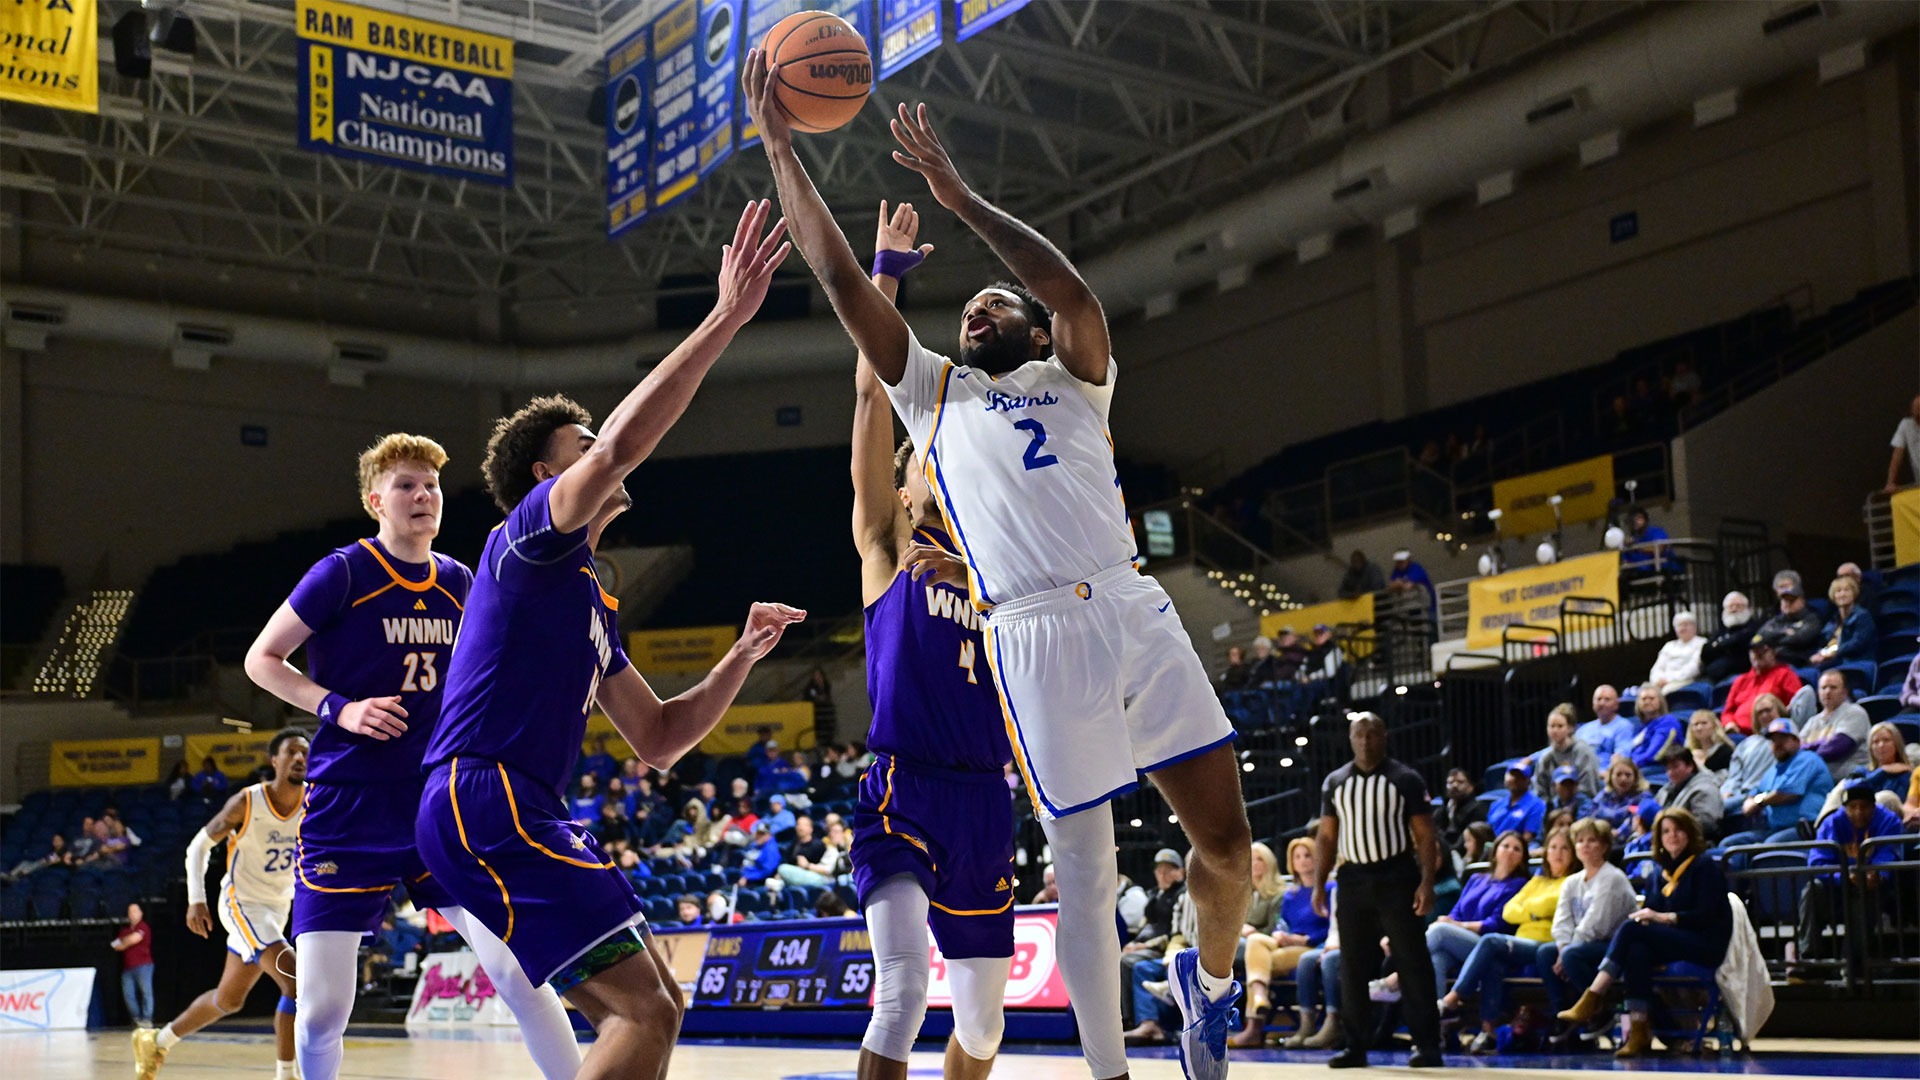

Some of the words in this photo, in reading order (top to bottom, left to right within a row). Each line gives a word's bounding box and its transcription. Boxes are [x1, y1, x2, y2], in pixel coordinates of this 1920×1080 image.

[305, 8, 354, 40] RAM
[367, 21, 506, 72] BASKETBALL
[0, 55, 80, 91] ions
[345, 52, 496, 107] NJCAA
[809, 63, 872, 86] Wilson
[359, 91, 484, 138] National
[336, 118, 507, 172] Champions
[985, 389, 1060, 412] Rams
[1013, 417, 1060, 471] 2
[925, 585, 986, 632] WNM
[382, 617, 454, 646] WNMU
[400, 651, 438, 693] 23
[958, 638, 979, 686] 4
[265, 830, 298, 844] Ram
[264, 847, 295, 873] 23
[707, 936, 743, 957] RAMS
[768, 938, 811, 967] 4:04
[701, 966, 728, 994] 65
[841, 962, 873, 993] 55
